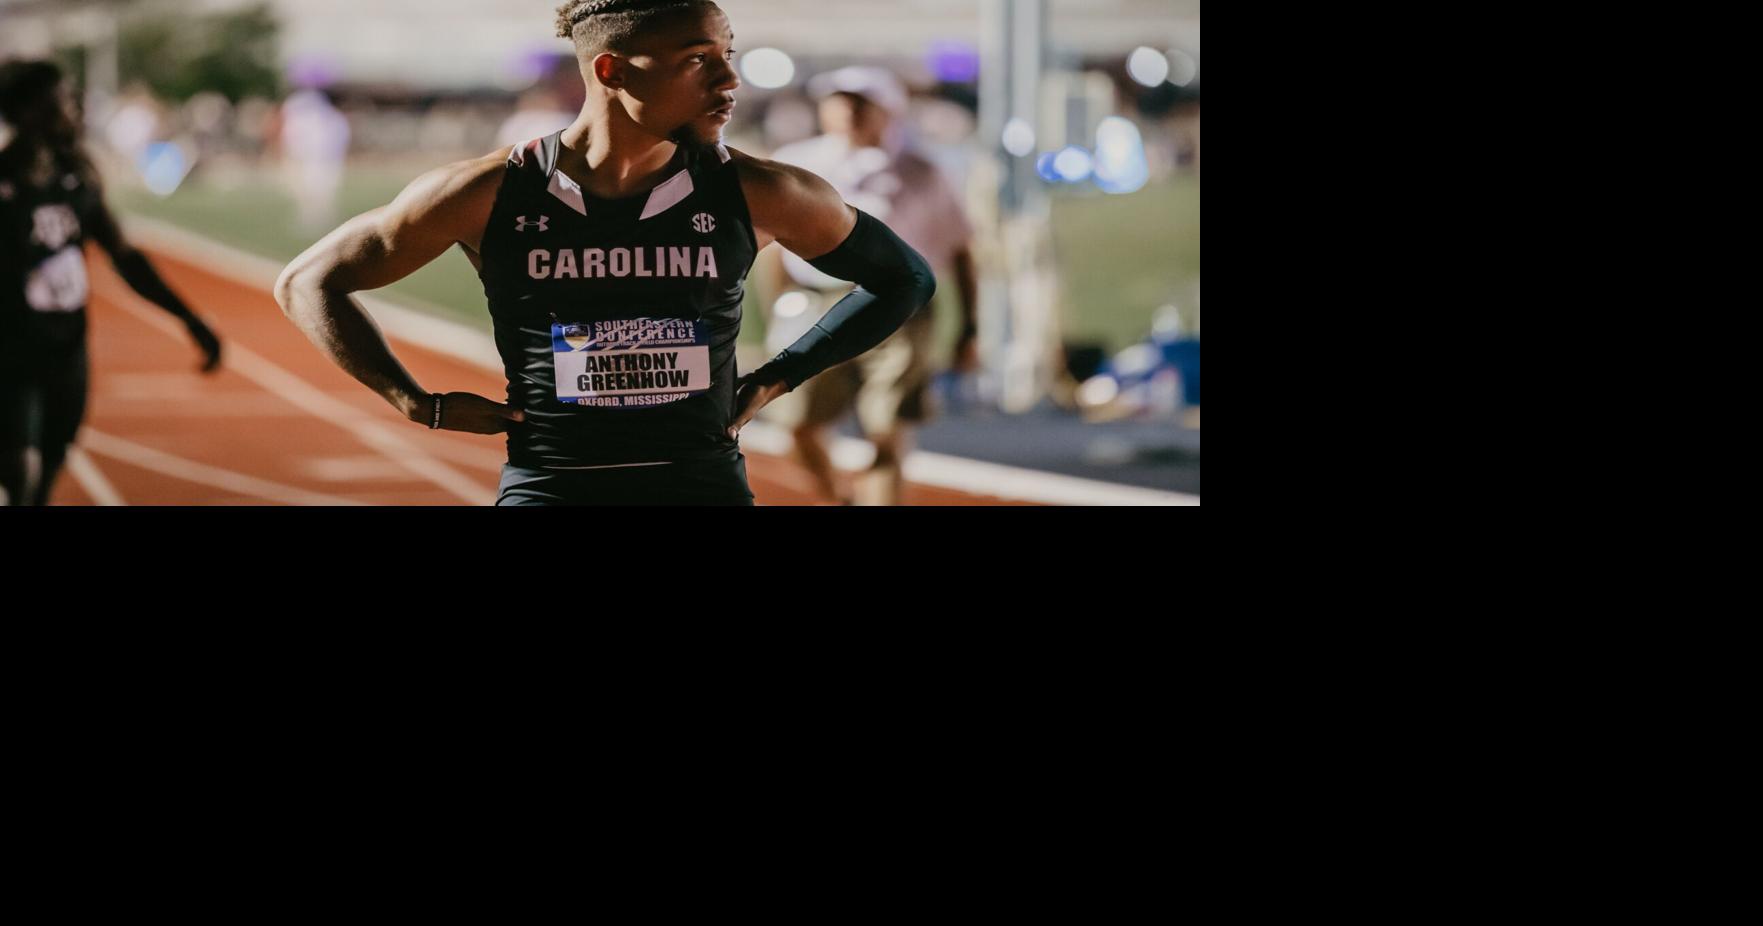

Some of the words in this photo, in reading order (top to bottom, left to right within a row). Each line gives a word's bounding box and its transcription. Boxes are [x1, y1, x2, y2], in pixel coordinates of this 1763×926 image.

[691, 212, 716, 233] SEC
[527, 246, 718, 280] CAROLINA
[595, 328, 696, 342] CONFERENCE
[585, 352, 678, 373] ANTHONY
[577, 370, 689, 392] GREENHOW
